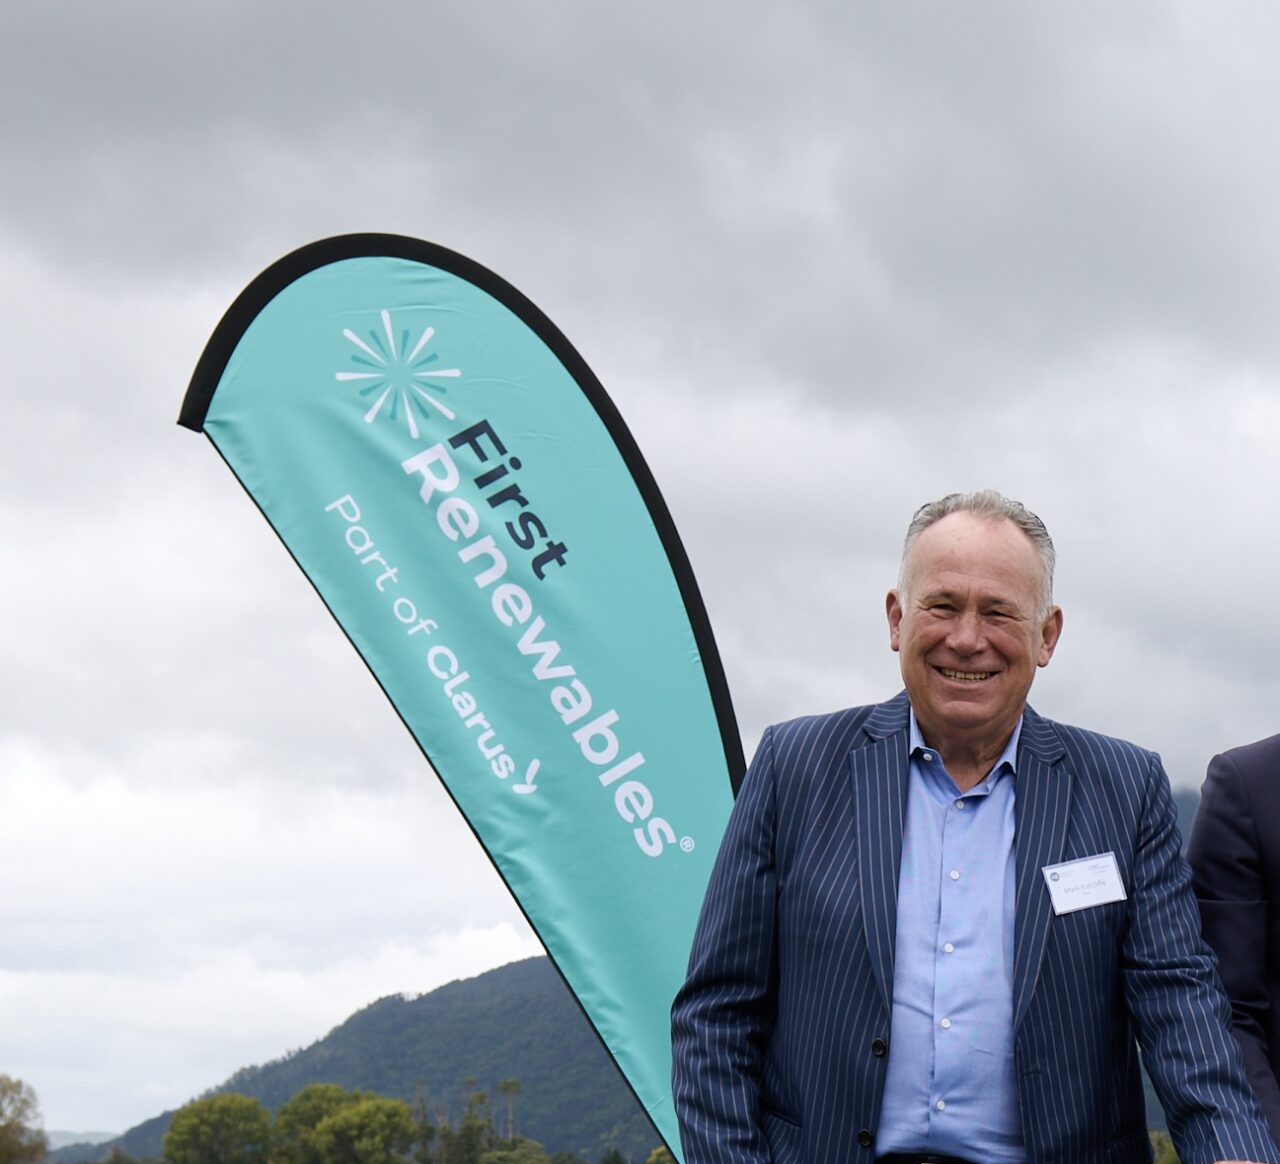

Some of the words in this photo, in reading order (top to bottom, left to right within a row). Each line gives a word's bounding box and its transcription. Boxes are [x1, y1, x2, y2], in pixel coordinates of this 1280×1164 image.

[447, 419, 569, 581] First
[324, 494, 399, 592] Part
[392, 597, 438, 637] of
[426, 645, 517, 780] Clarus
